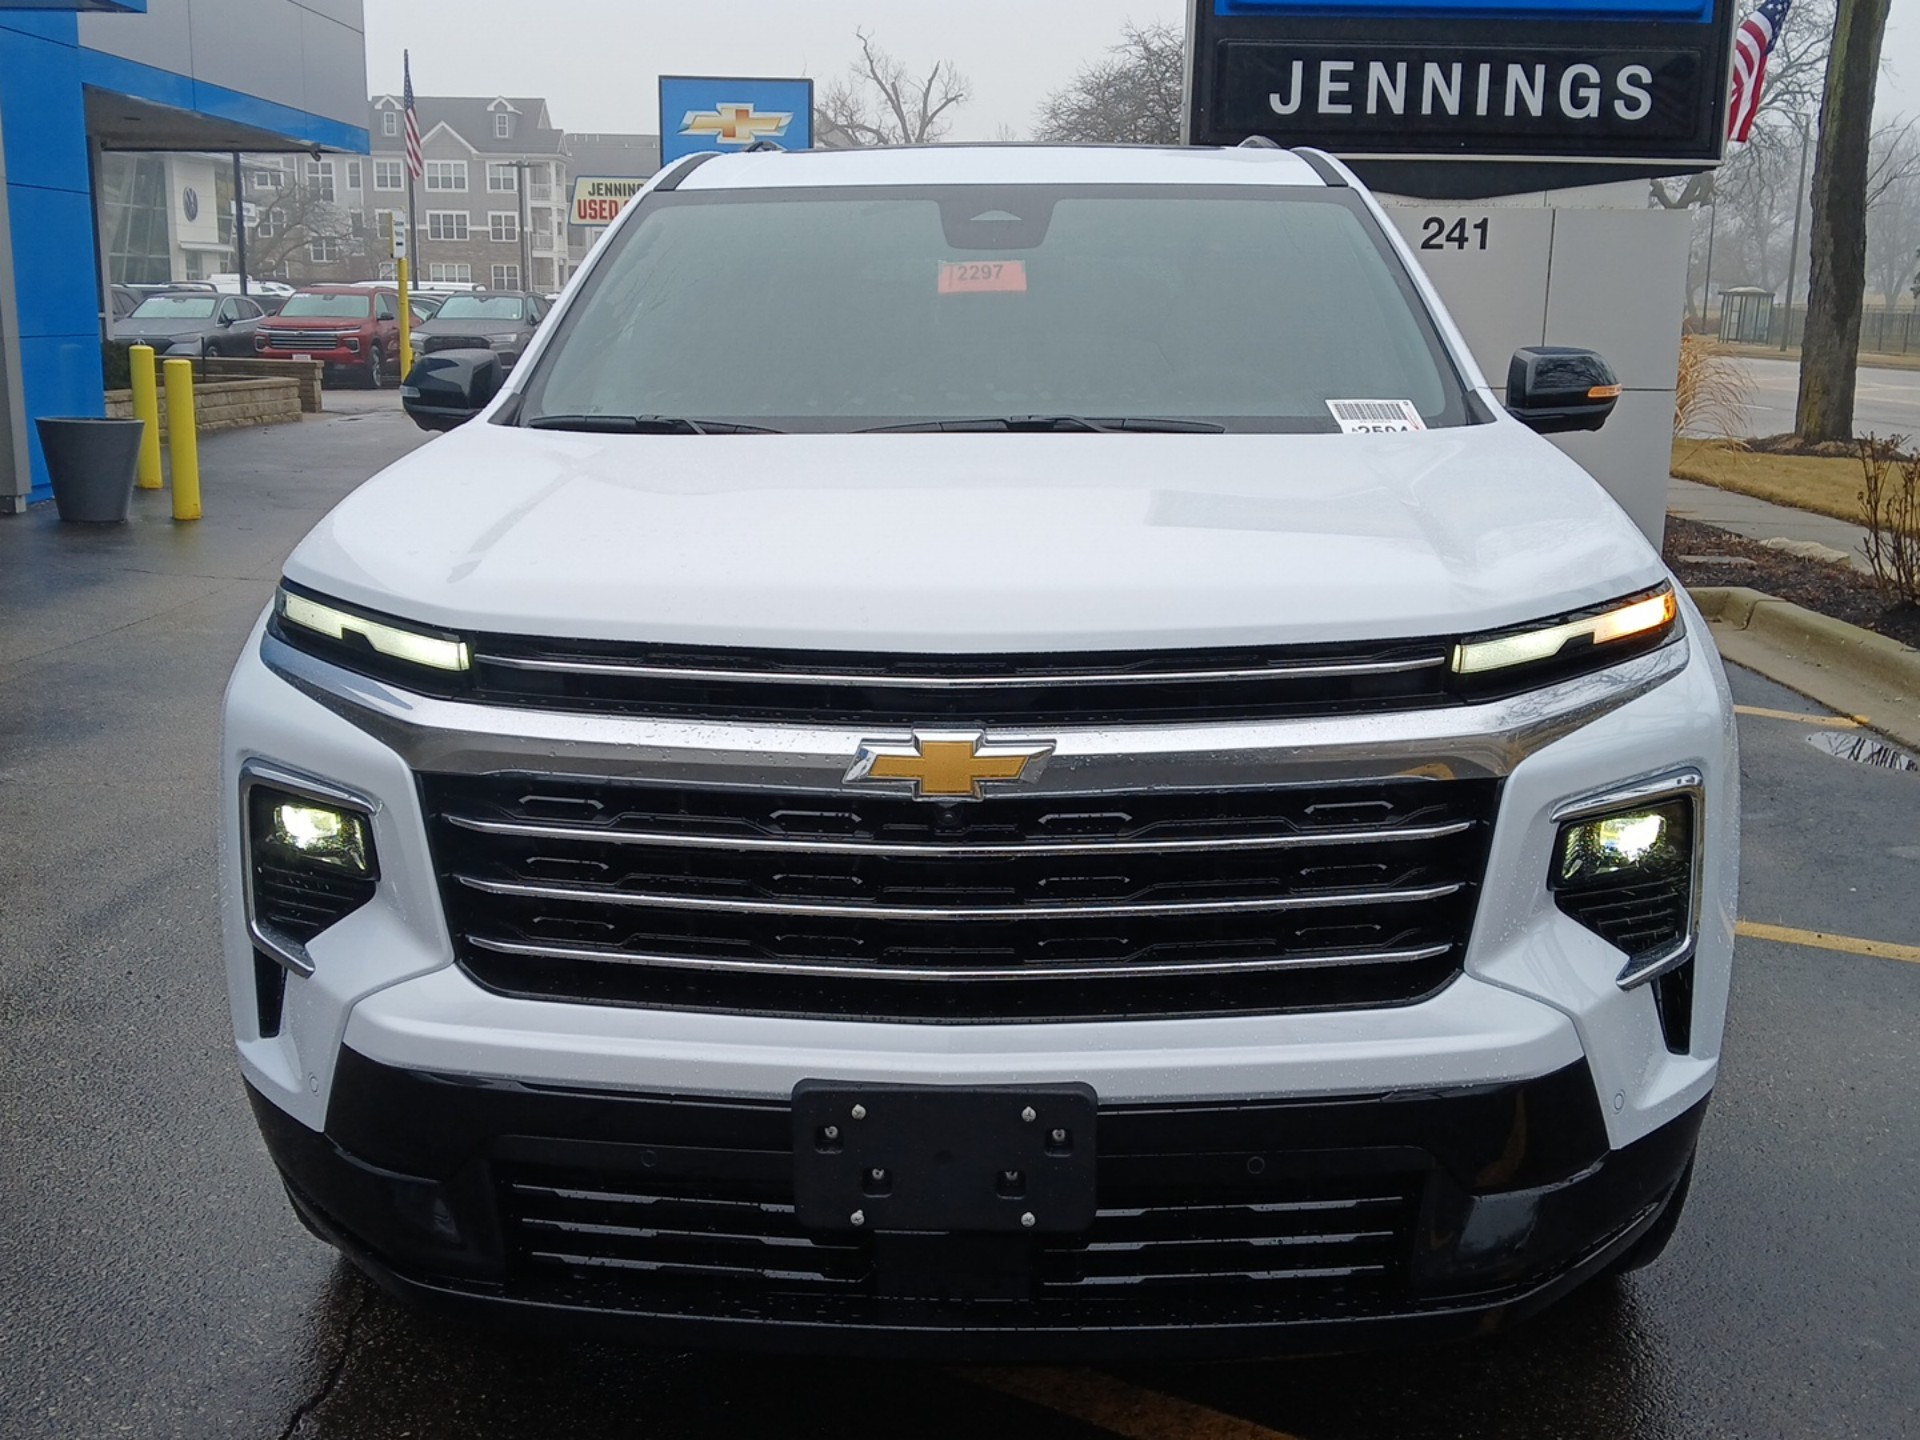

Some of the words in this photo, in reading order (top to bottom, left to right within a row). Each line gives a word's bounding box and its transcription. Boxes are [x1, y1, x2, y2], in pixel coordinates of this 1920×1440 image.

[1269, 60, 1654, 120] JENNINGS
[577, 199, 619, 220] USED
[1420, 216, 1489, 250] 241
